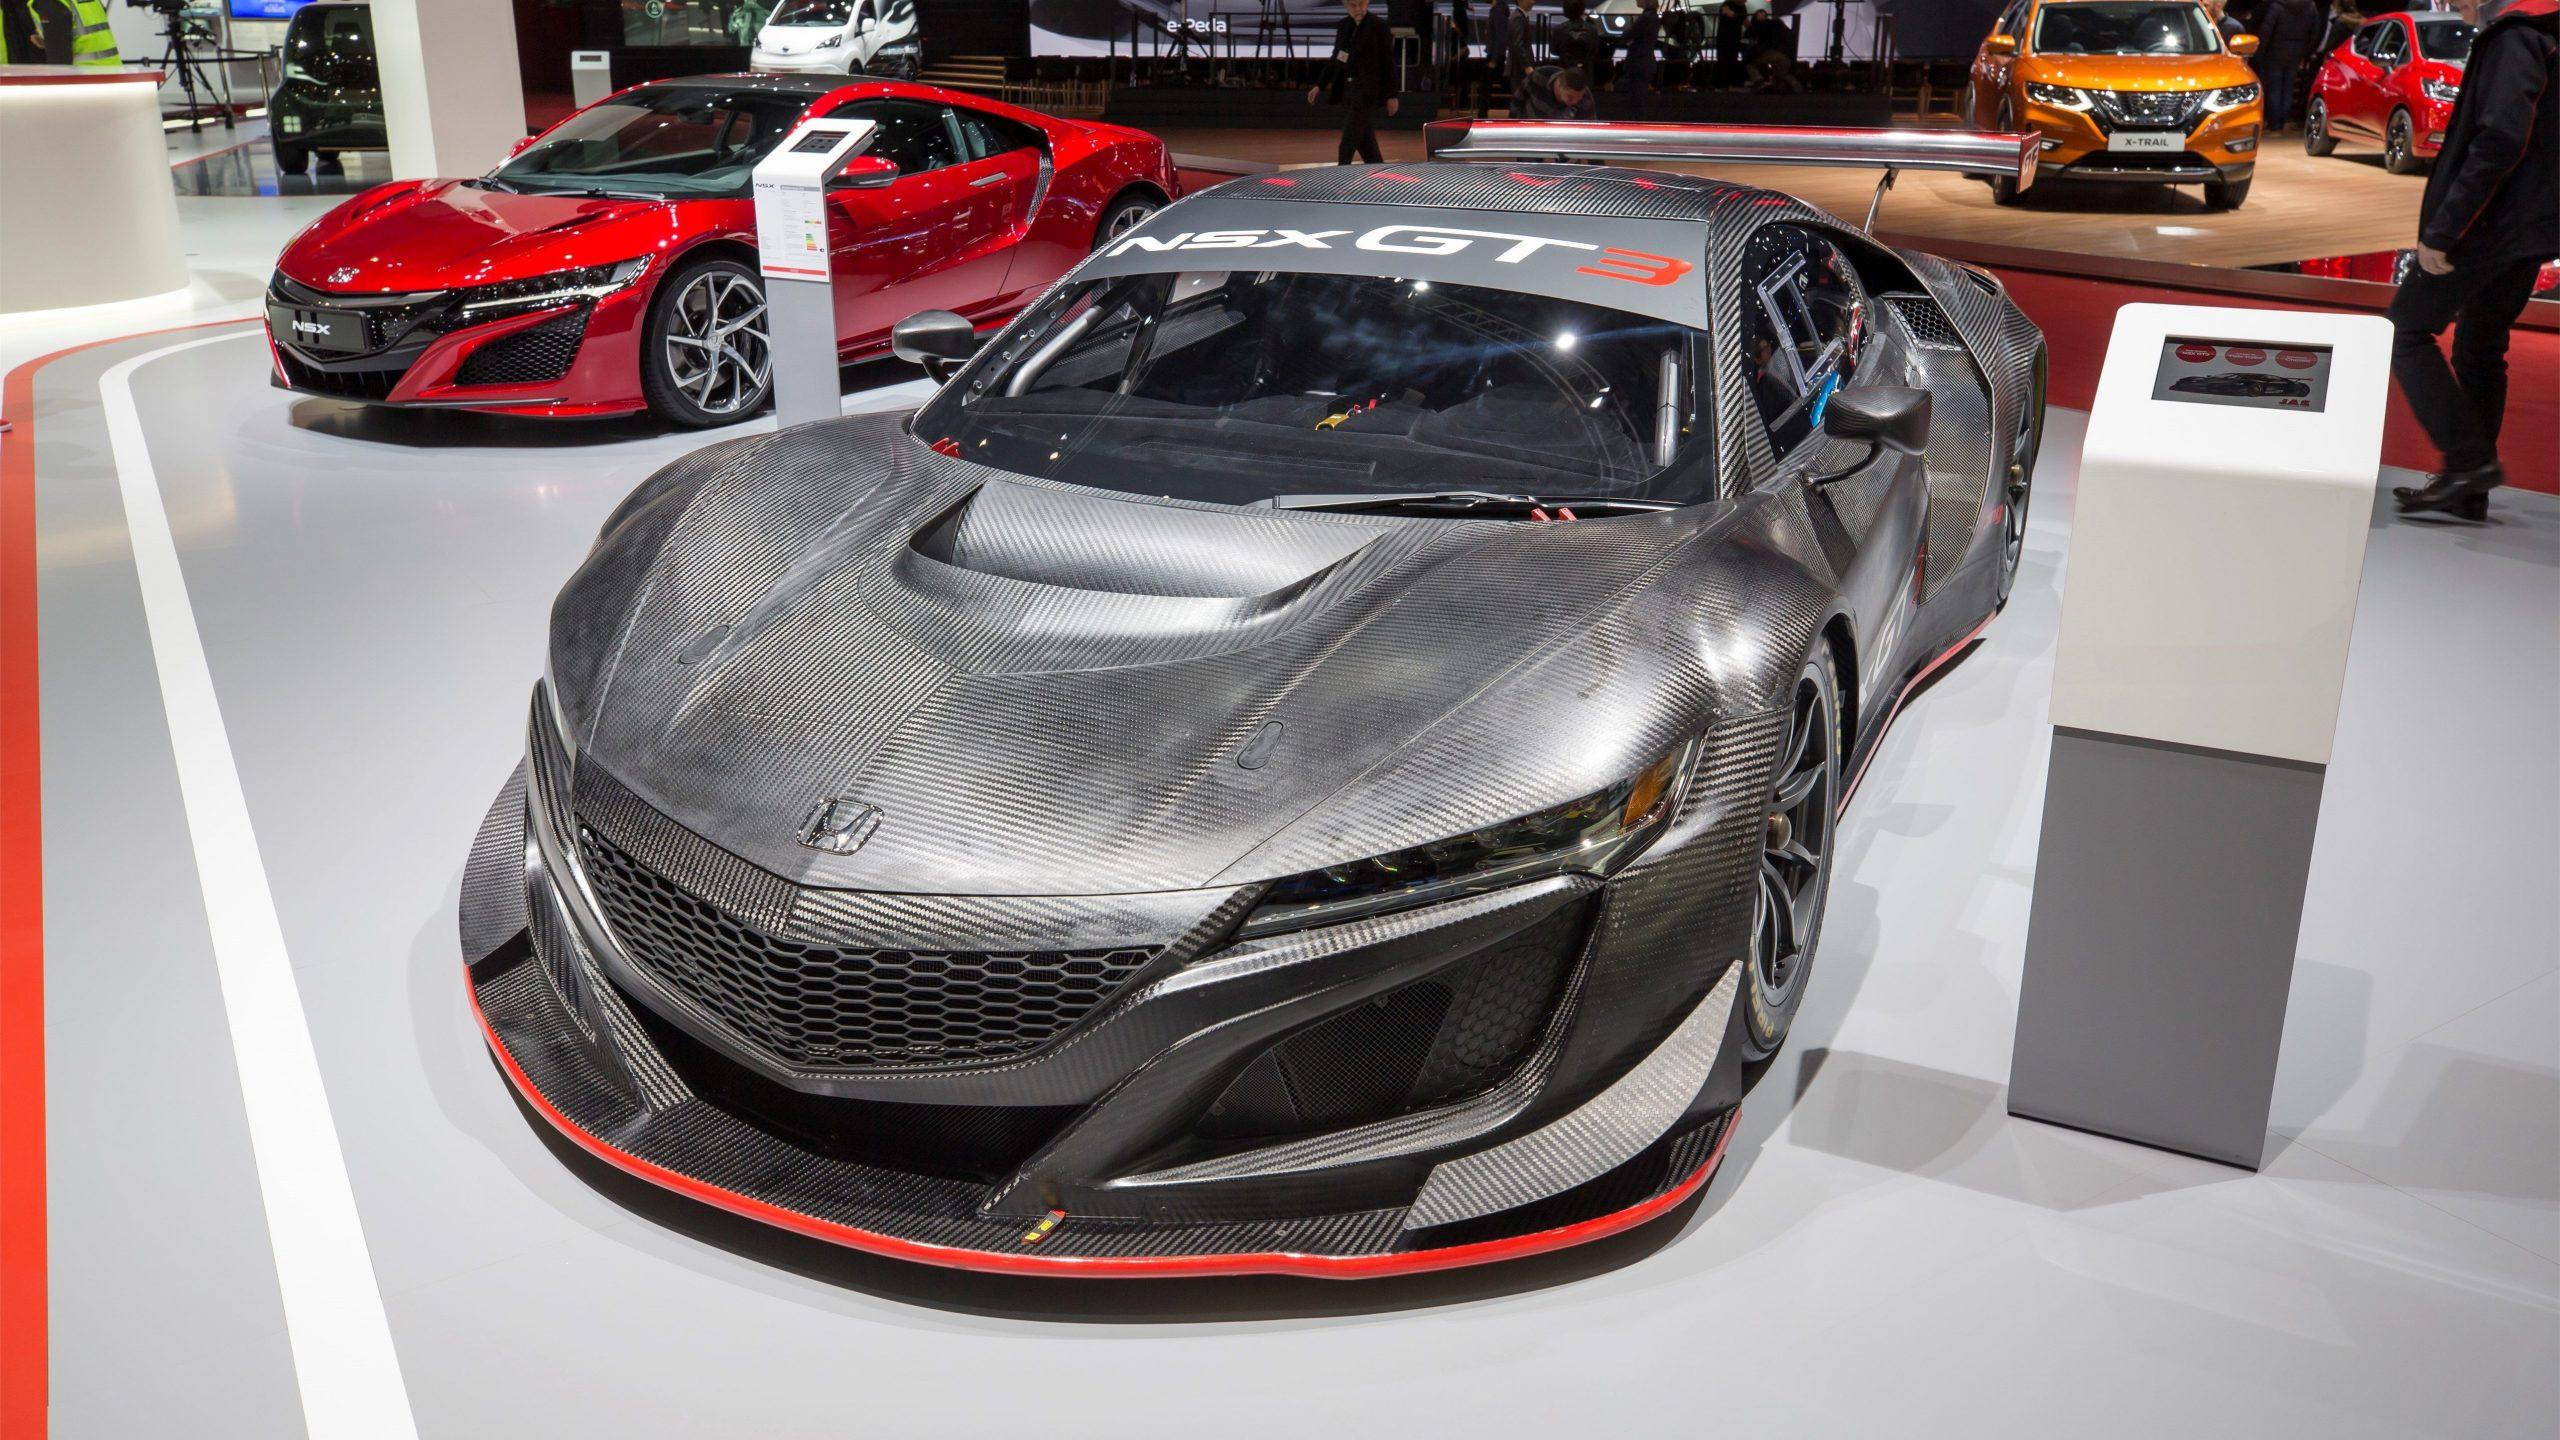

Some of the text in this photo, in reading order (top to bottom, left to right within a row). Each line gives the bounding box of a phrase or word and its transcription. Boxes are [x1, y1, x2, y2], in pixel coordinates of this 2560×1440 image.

[1166, 18, 1229, 32] e-Peda
[2125, 138, 2169, 147] X-TRAIL
[1106, 224, 1694, 287] NSX GT3
[292, 320, 331, 335] NSX
